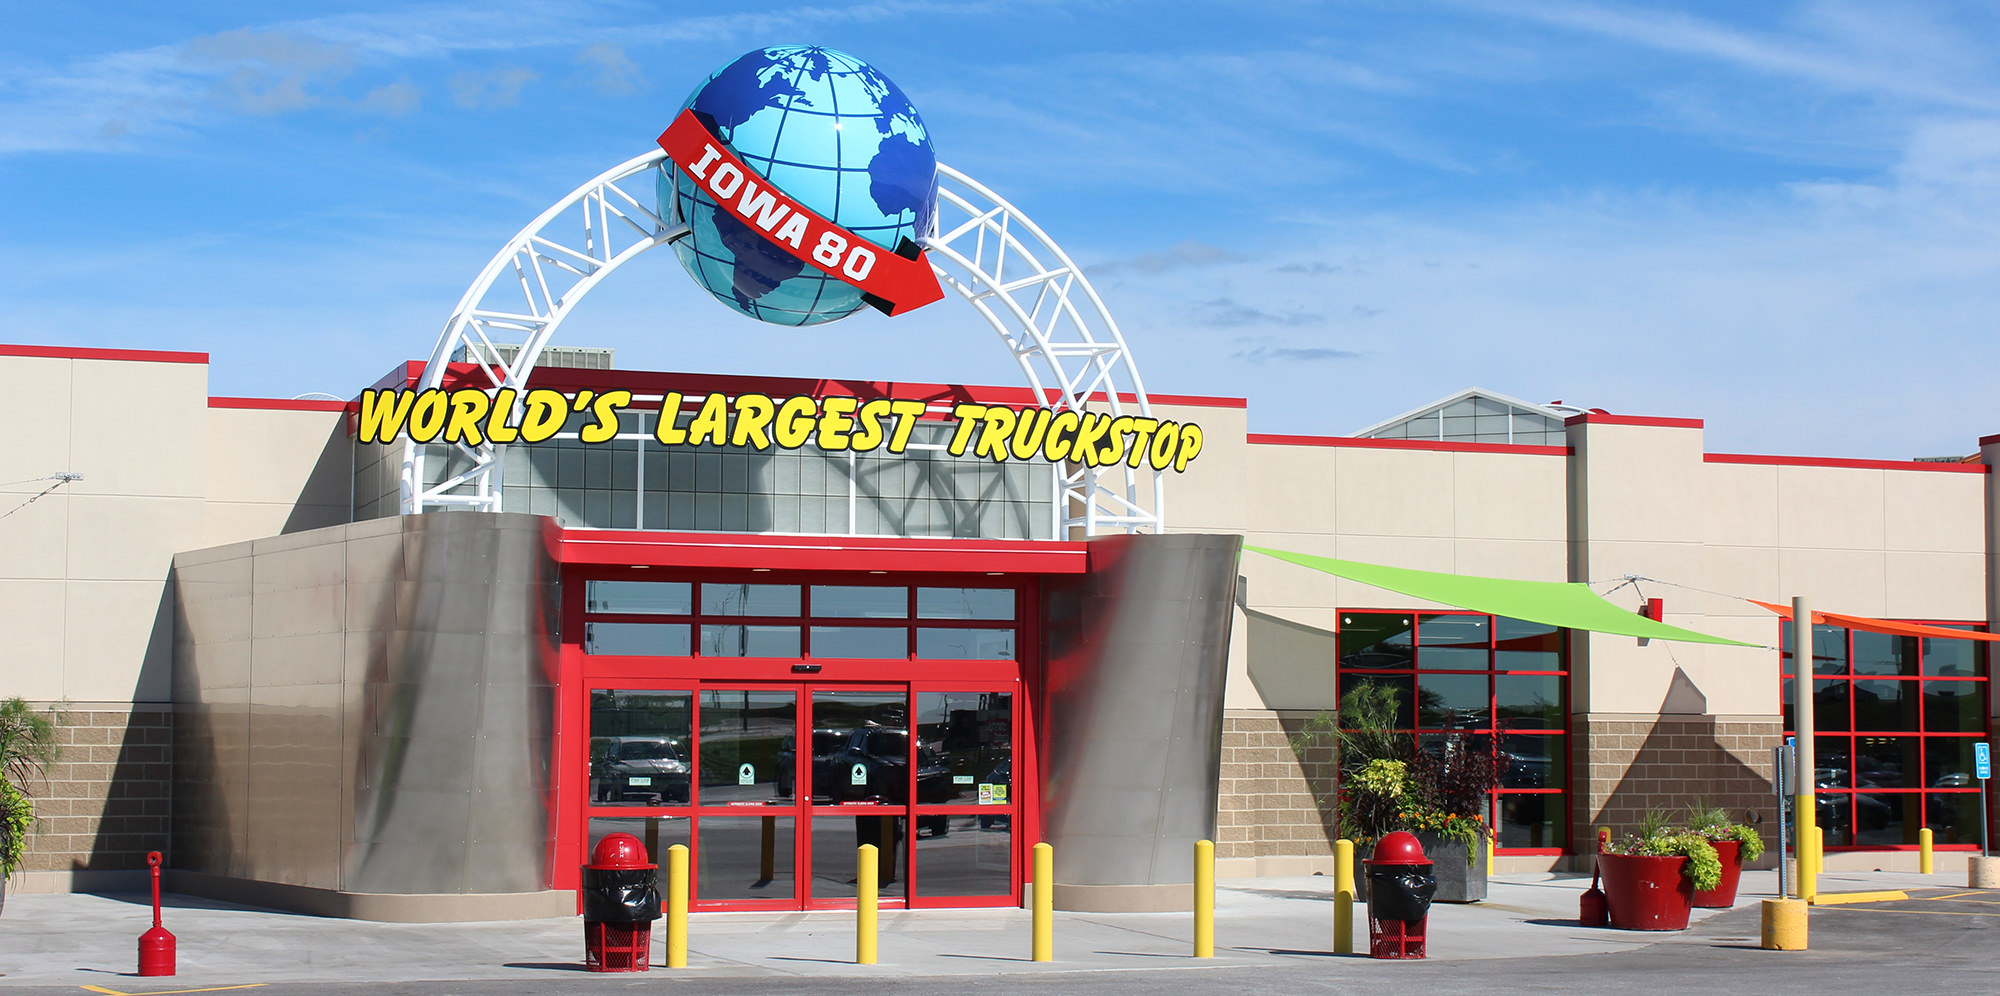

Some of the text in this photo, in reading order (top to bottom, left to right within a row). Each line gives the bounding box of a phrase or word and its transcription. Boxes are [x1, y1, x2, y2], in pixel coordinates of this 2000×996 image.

[688, 143, 876, 282] IOWA 80
[358, 387, 1204, 473] WORLD'S LARGEST TRUCKSTOP
